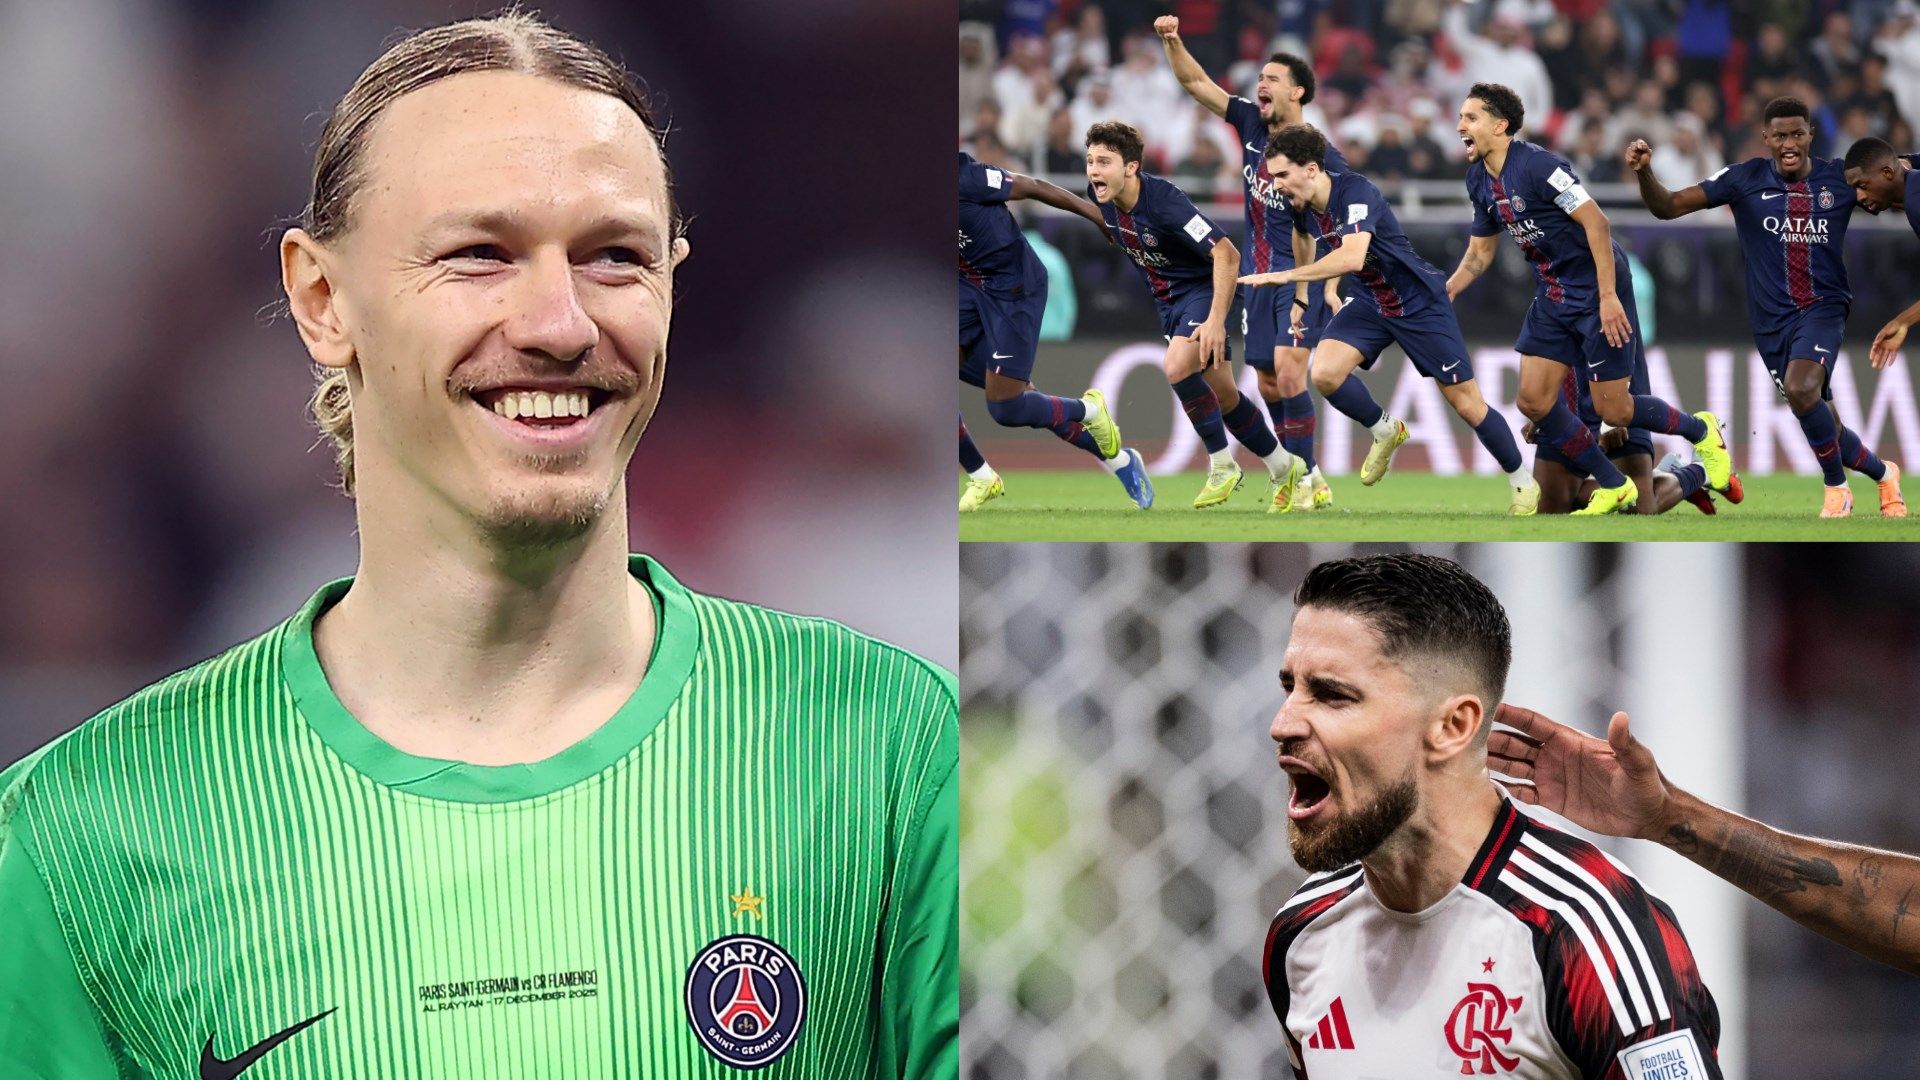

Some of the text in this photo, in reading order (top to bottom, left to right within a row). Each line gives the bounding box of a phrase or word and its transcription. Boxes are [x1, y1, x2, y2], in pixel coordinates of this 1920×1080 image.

[1763, 216, 1829, 235] QATAR
[1780, 232, 1829, 244] AIRWAYS
[704, 943, 784, 976] PARIS
[418, 970, 598, 1001] PARIS SAINT-GERMAIN vs CR FLAMENGO
[423, 1004, 437, 1012] AL
[438, 1000, 484, 1011] RAYYAN
[494, 997, 504, 1006] 17
[506, 991, 566, 1005] DECEMBER
[568, 988, 598, 999] 2025
[1640, 1048, 1684, 1071] FOOTBALL
[1642, 1060, 1688, 1080] UNITES
